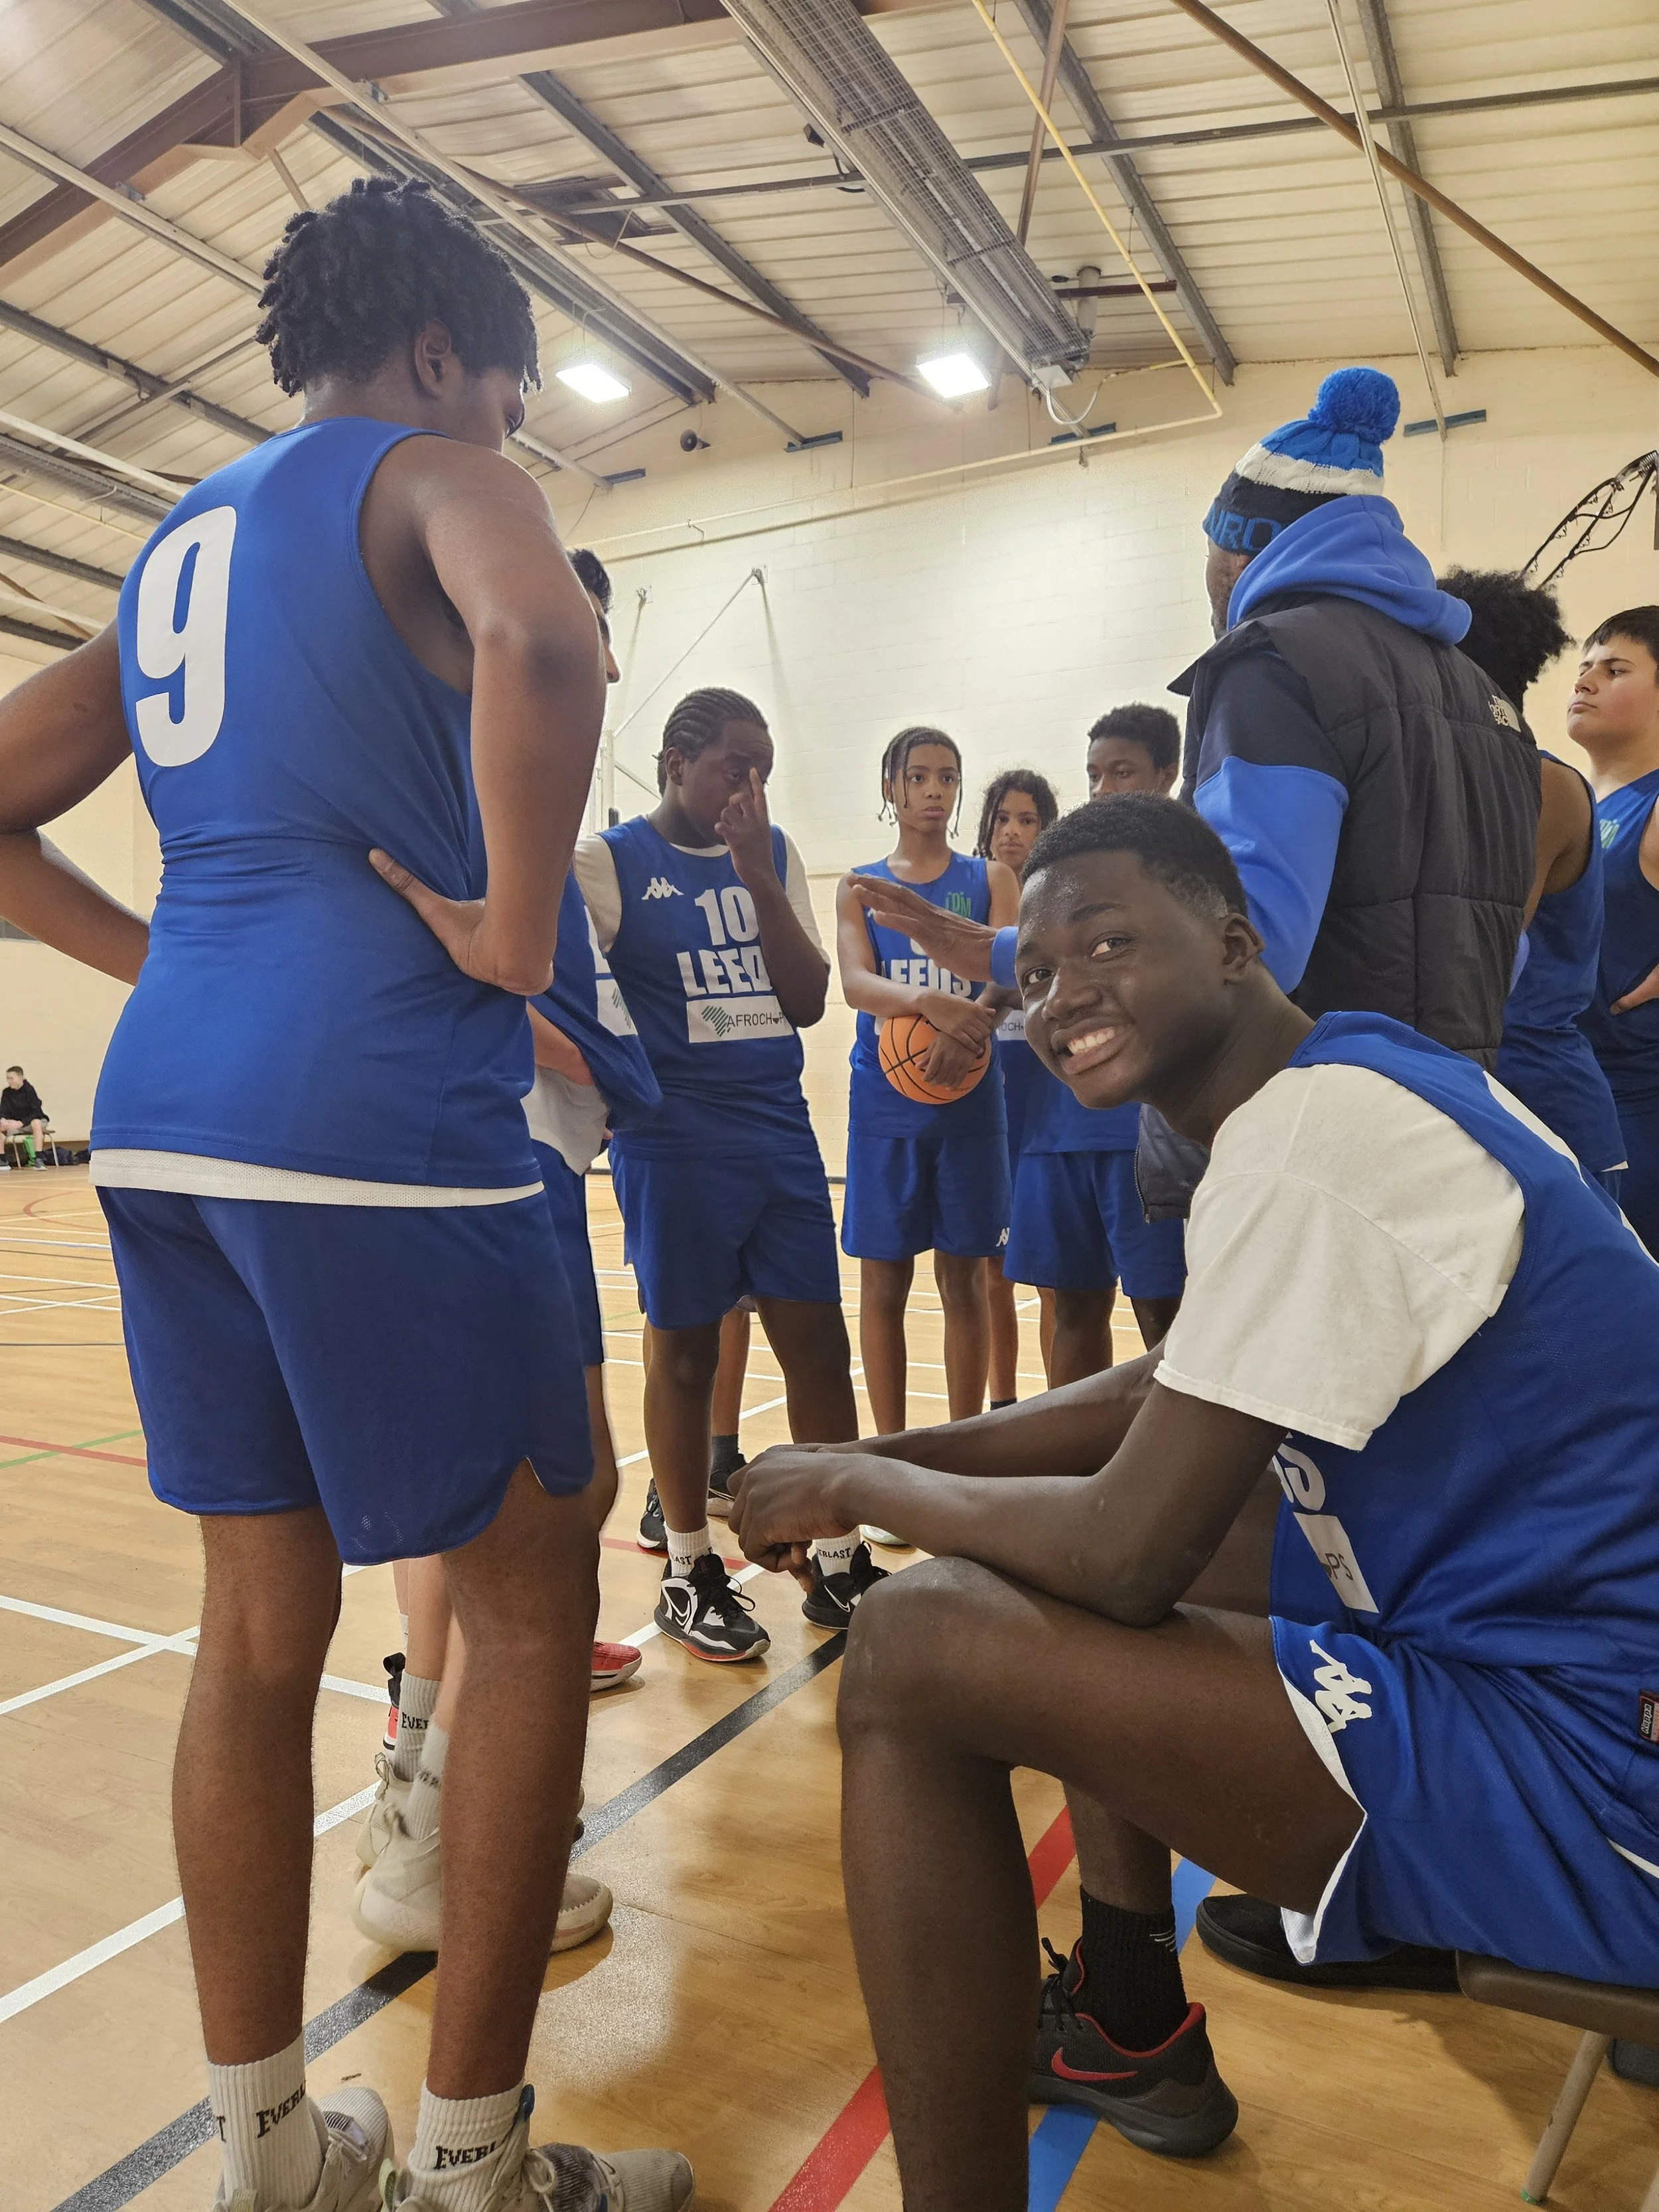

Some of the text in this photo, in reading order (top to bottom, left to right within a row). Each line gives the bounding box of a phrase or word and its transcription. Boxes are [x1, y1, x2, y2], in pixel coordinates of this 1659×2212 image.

[135, 506, 236, 767] 9
[695, 887, 759, 946] 10
[676, 946, 772, 997] LEED
[881, 958, 972, 997] EEDS
[817, 1547, 851, 1559] ERLAST
